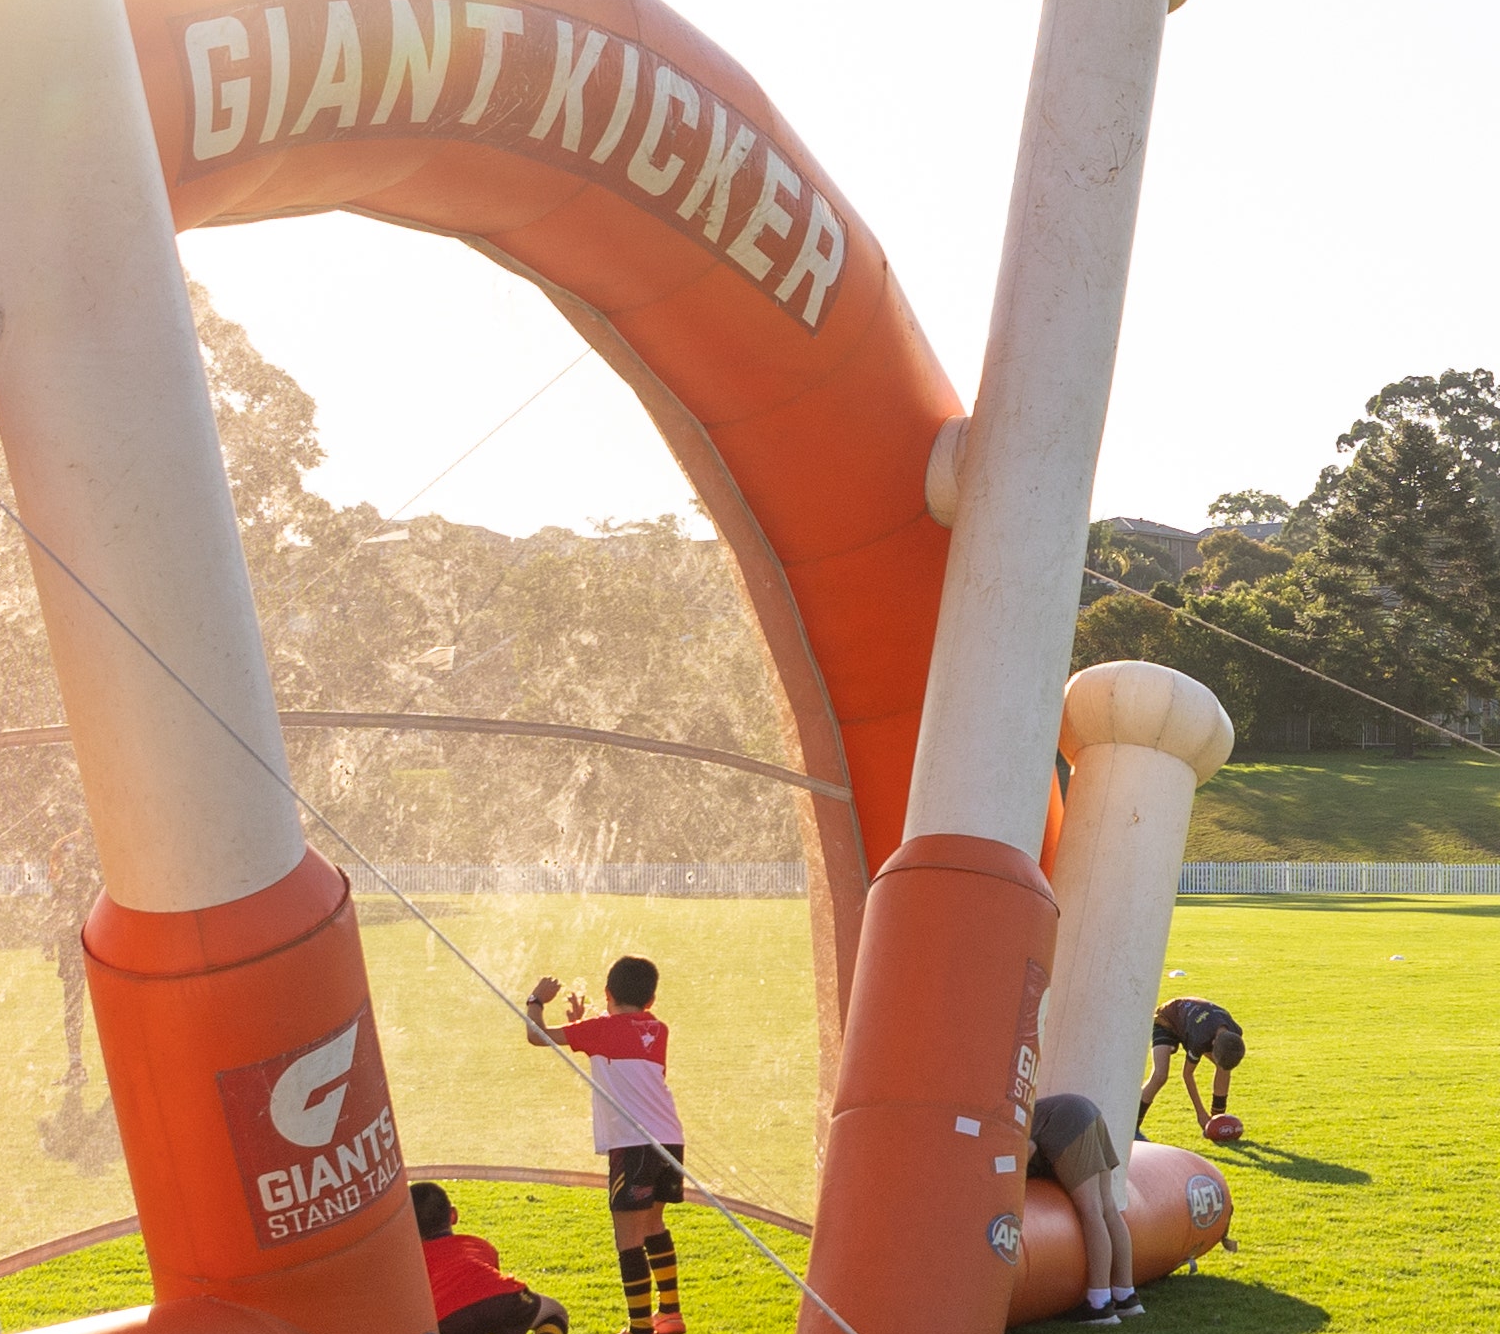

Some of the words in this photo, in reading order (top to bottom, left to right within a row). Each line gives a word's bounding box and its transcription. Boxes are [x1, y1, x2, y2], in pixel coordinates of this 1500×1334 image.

[526, 19, 847, 328] KICKER
[257, 1105, 395, 1212] GIANTS
[268, 1184, 361, 1239] STAND
[363, 1149, 401, 1196] TALL
[1191, 1184, 1223, 1218] AFL
